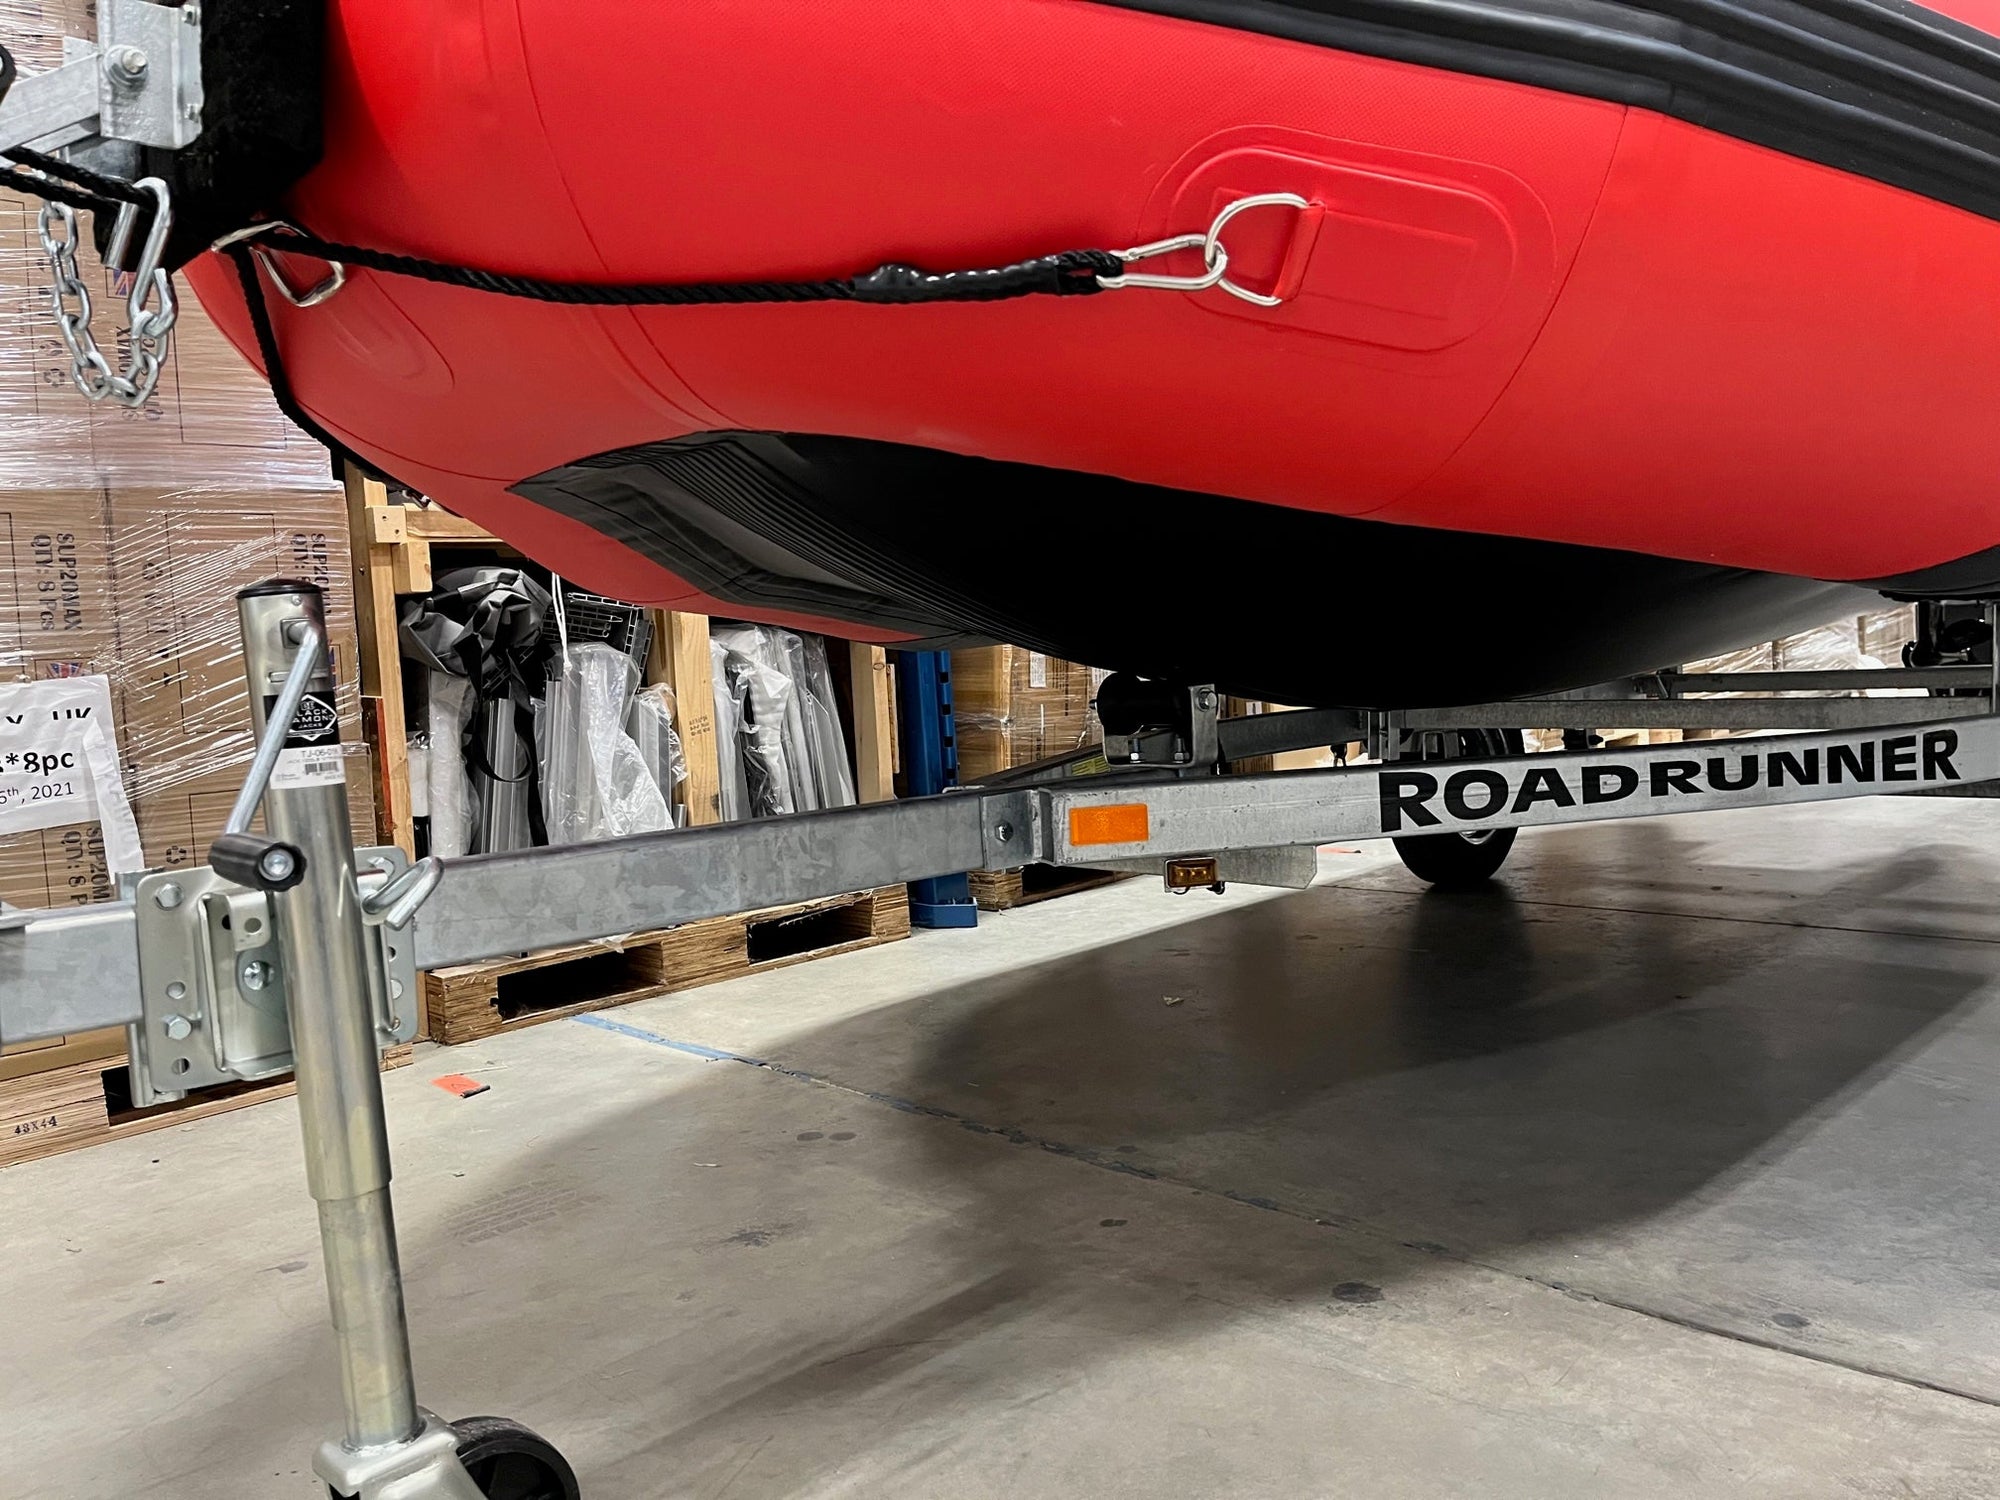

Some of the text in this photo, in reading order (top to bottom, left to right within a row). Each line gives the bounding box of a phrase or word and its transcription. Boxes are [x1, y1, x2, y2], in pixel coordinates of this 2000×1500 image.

[31, 534, 54, 574] QTY:
[290, 533, 310, 569] QTY:
[38, 580, 56, 592] 8
[56, 533, 82, 630] SUP20MAX
[296, 708, 328, 717] LACK
[30, 781, 74, 800] 2021
[1378, 728, 1962, 833] ROADRUNNER
[61, 830, 84, 869] QTY:
[86, 826, 110, 903] SUP20M
[68, 875, 87, 887] 8
